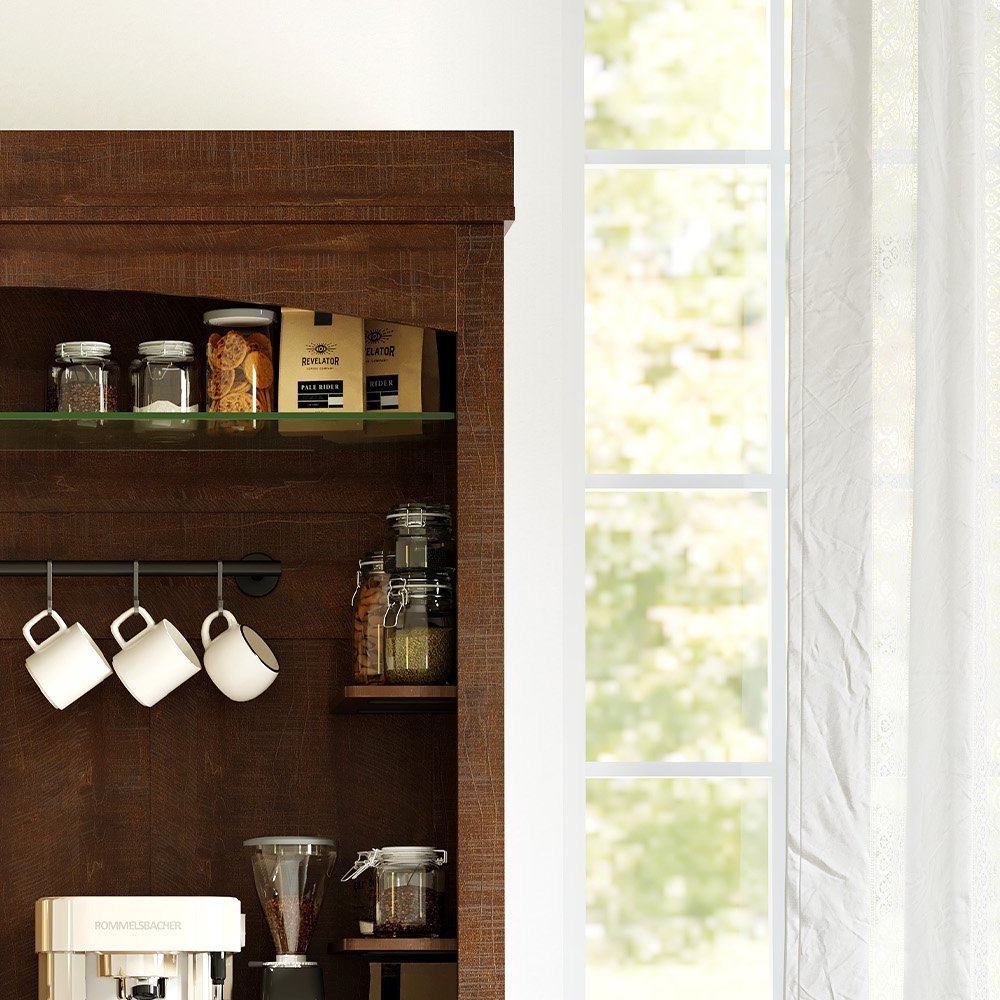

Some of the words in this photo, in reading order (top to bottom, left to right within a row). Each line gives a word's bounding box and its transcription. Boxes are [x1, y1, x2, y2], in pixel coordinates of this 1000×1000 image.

[365, 345, 395, 357] ELATOR
[301, 357, 339, 366] REVELATOR
[369, 379, 394, 388] RIDER
[95, 921, 181, 931] ROMMELSBACHER
